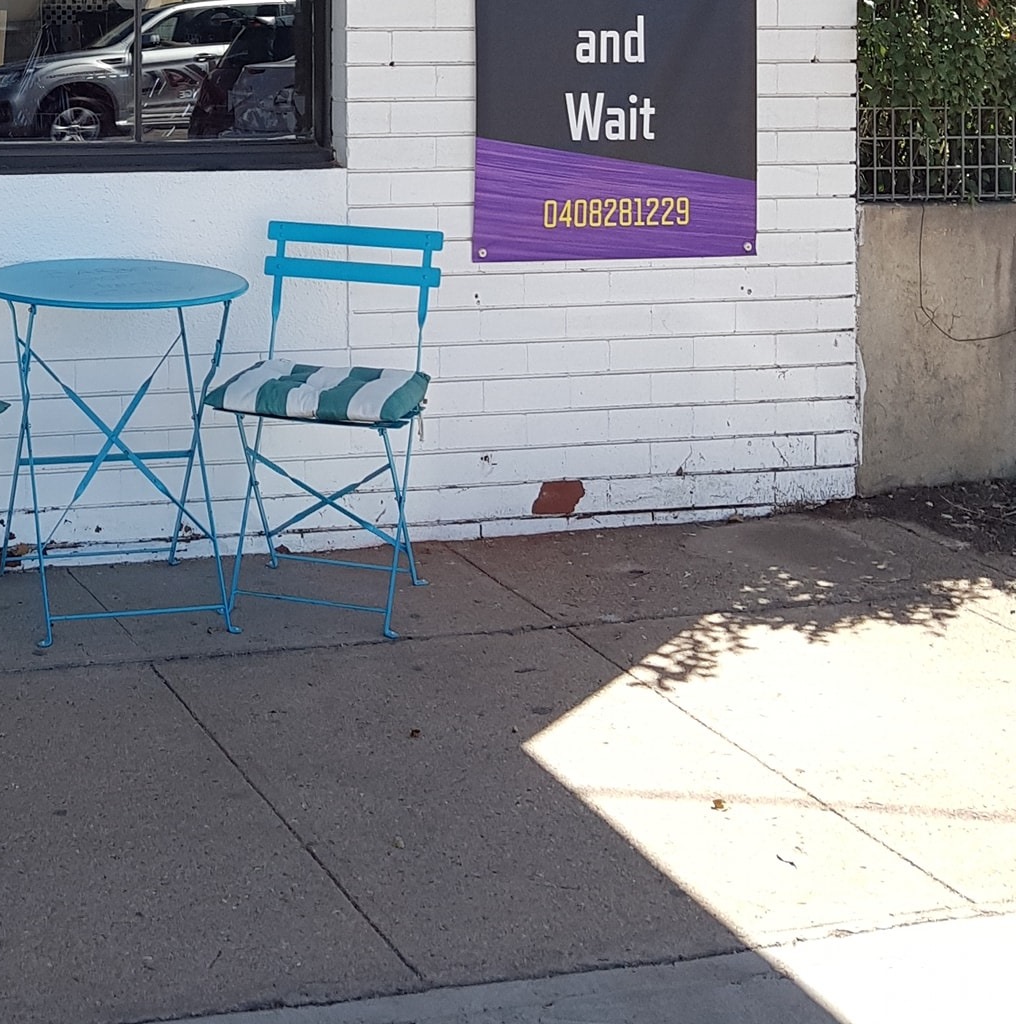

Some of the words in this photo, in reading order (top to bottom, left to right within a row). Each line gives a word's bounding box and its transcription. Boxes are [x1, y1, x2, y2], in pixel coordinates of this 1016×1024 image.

[575, 14, 646, 64] and
[565, 92, 657, 142] Wait
[543, 197, 690, 229] 0408281229
